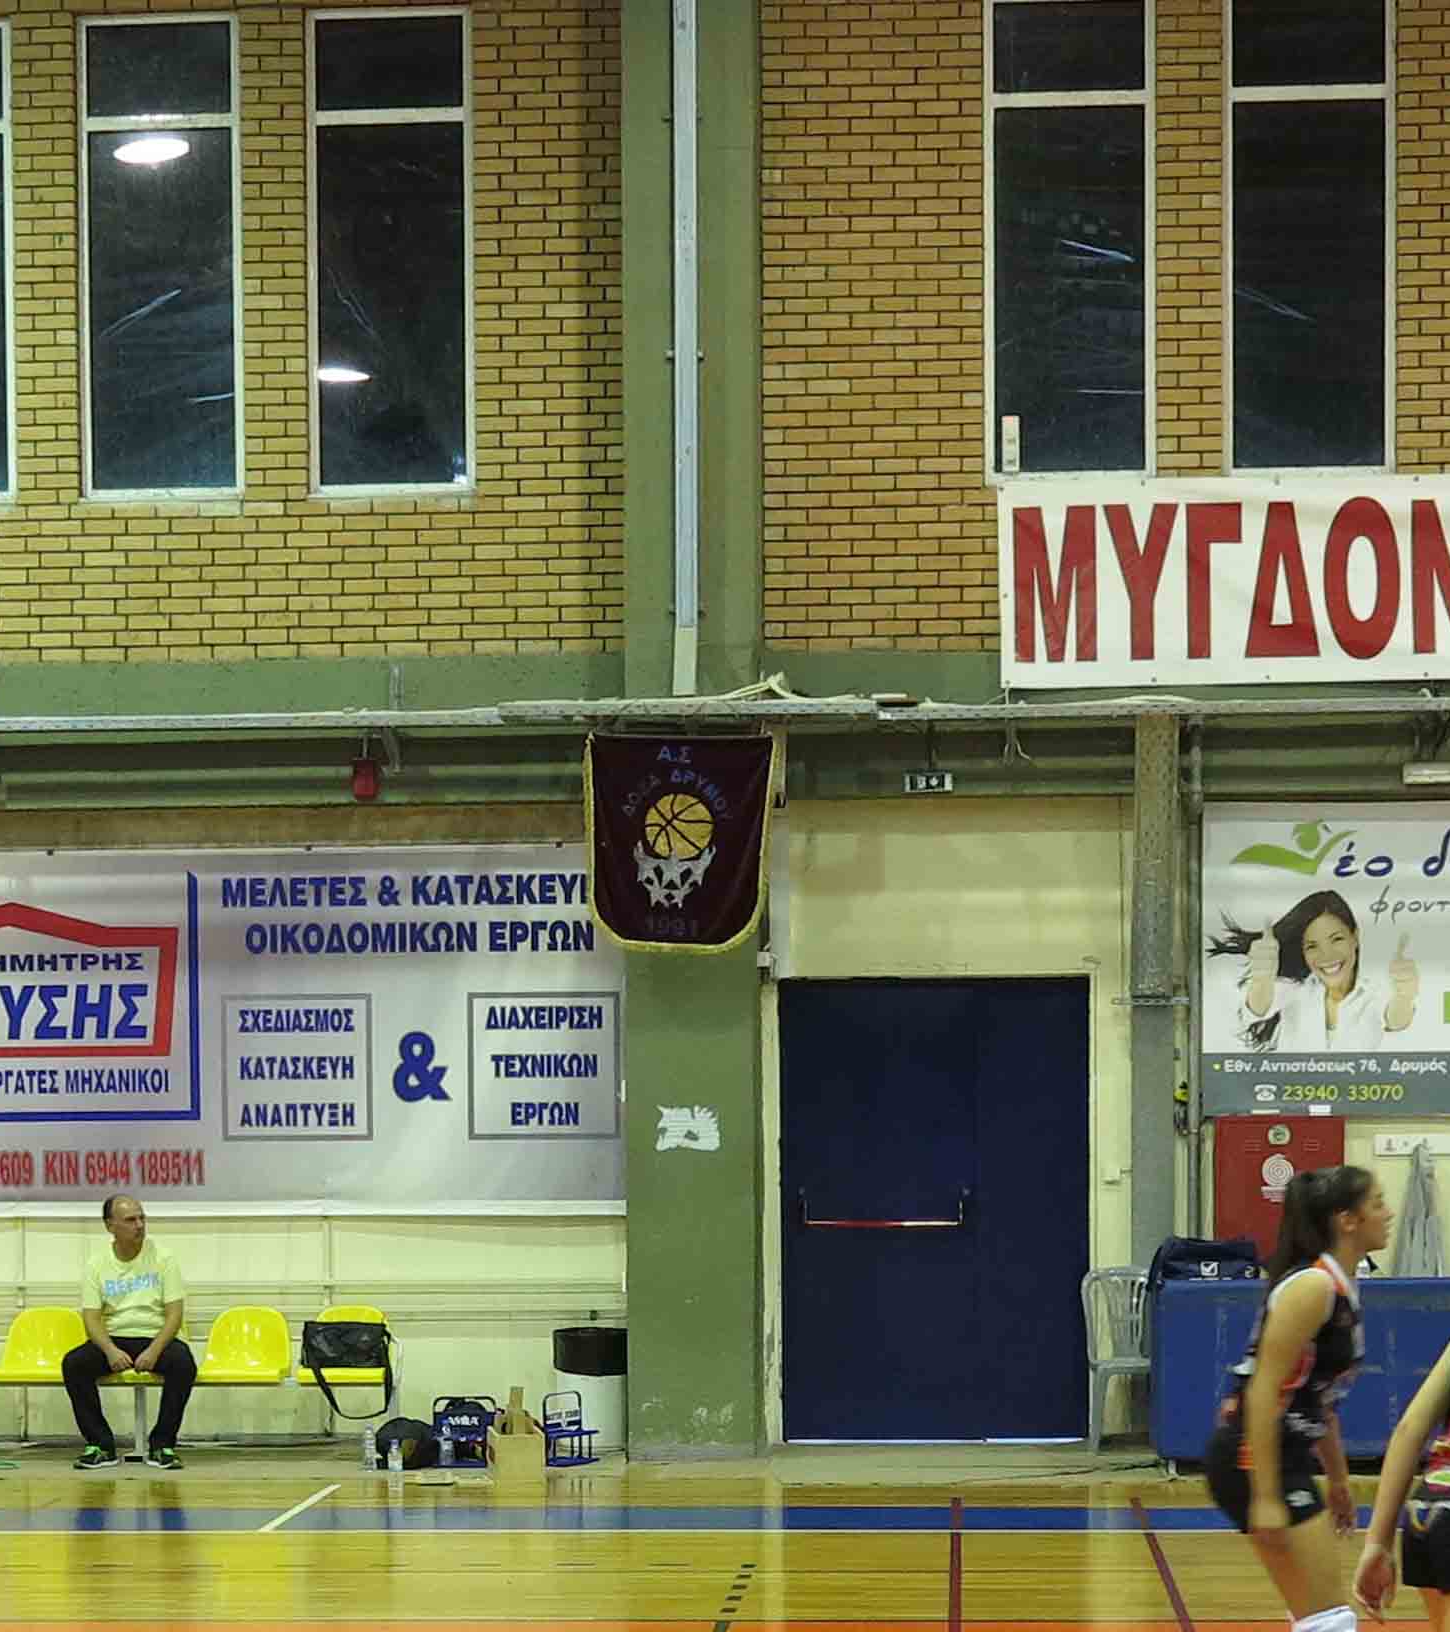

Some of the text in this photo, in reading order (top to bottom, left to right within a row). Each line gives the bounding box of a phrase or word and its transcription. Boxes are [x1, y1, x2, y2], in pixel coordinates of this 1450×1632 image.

[220, 876, 368, 908] ΜΕΛΕΤΕΣ
[377, 877, 401, 907] &
[244, 919, 595, 955] ΟΙΚΟΔΟΜΙΚΩΝ ΕΡΓΩΝ
[238, 1008, 355, 1033] ΣΧΕΔΙΑΣΜΟΣ
[484, 1005, 603, 1031] ΔΙΑΧΕΙΡΙΣΗ
[239, 1056, 355, 1081] ΚΑΤΑΣΚΕΥΗ
[392, 1031, 450, 1102] &
[490, 1054, 599, 1079] ΤΕΧΝΙΚΩΝ
[1224, 1060, 1255, 1074] Εθν.
[1389, 1059, 1448, 1076] Δρυμός
[64, 1067, 170, 1094] ΜΗΧΑΝΙΚΟΙ
[1282, 1084, 1404, 1102] 23940 33070
[239, 1103, 356, 1128] ΑΝΑΠΤΥΞΗ
[509, 1101, 581, 1127] ΕΡΓΩΝ
[42, 1150, 81, 1187] ΚΙΝ
[84, 1150, 132, 1186] 6944
[136, 1149, 206, 1186] 189511
